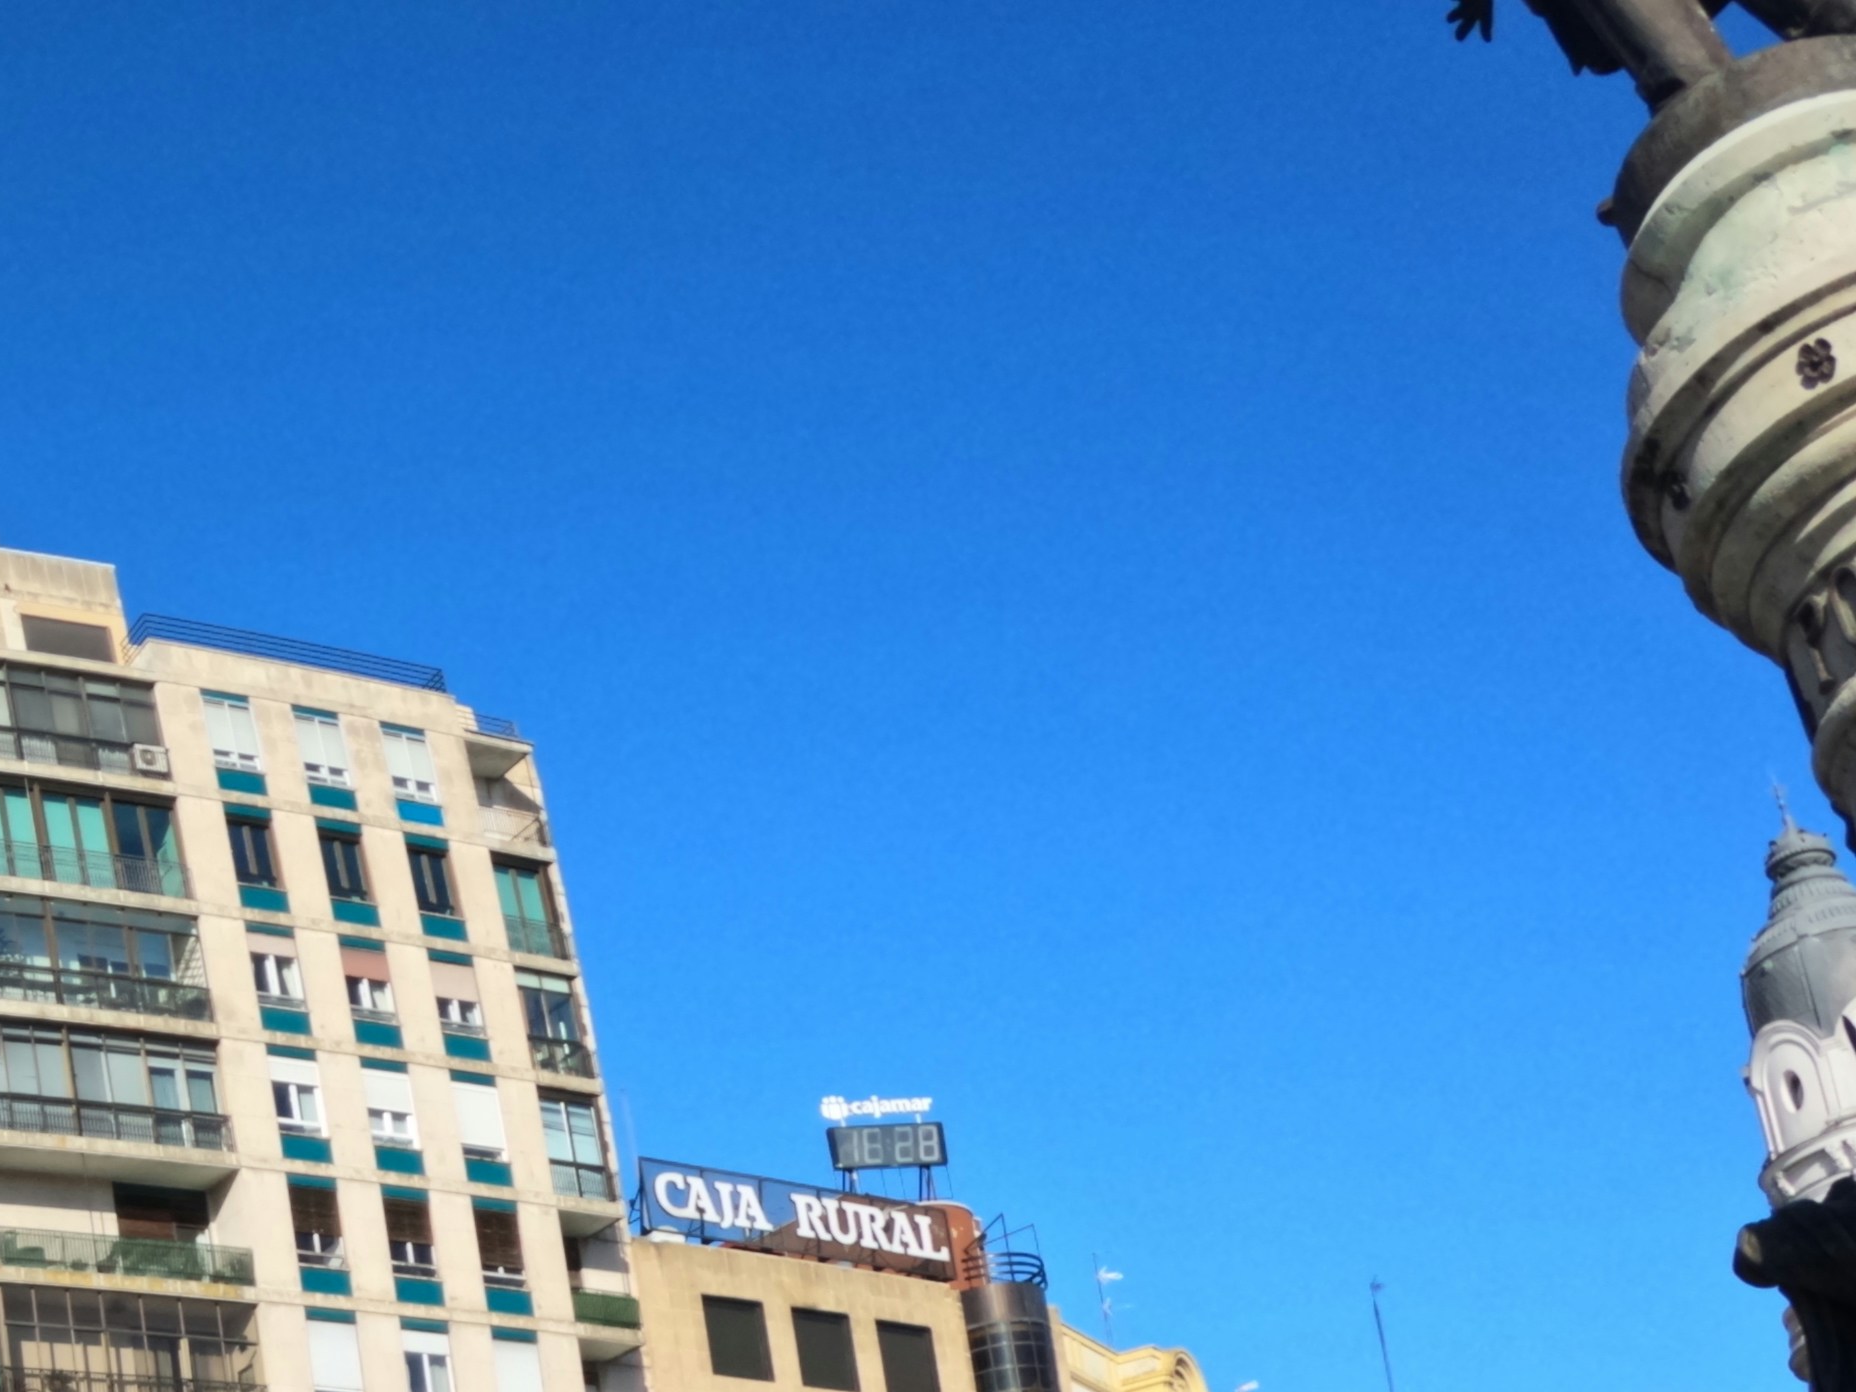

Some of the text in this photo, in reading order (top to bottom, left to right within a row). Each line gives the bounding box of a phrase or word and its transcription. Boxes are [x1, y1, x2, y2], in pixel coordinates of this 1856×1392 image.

[850, 1095, 933, 1119] cajamar
[653, 1170, 951, 1262] CAJA RURAL
